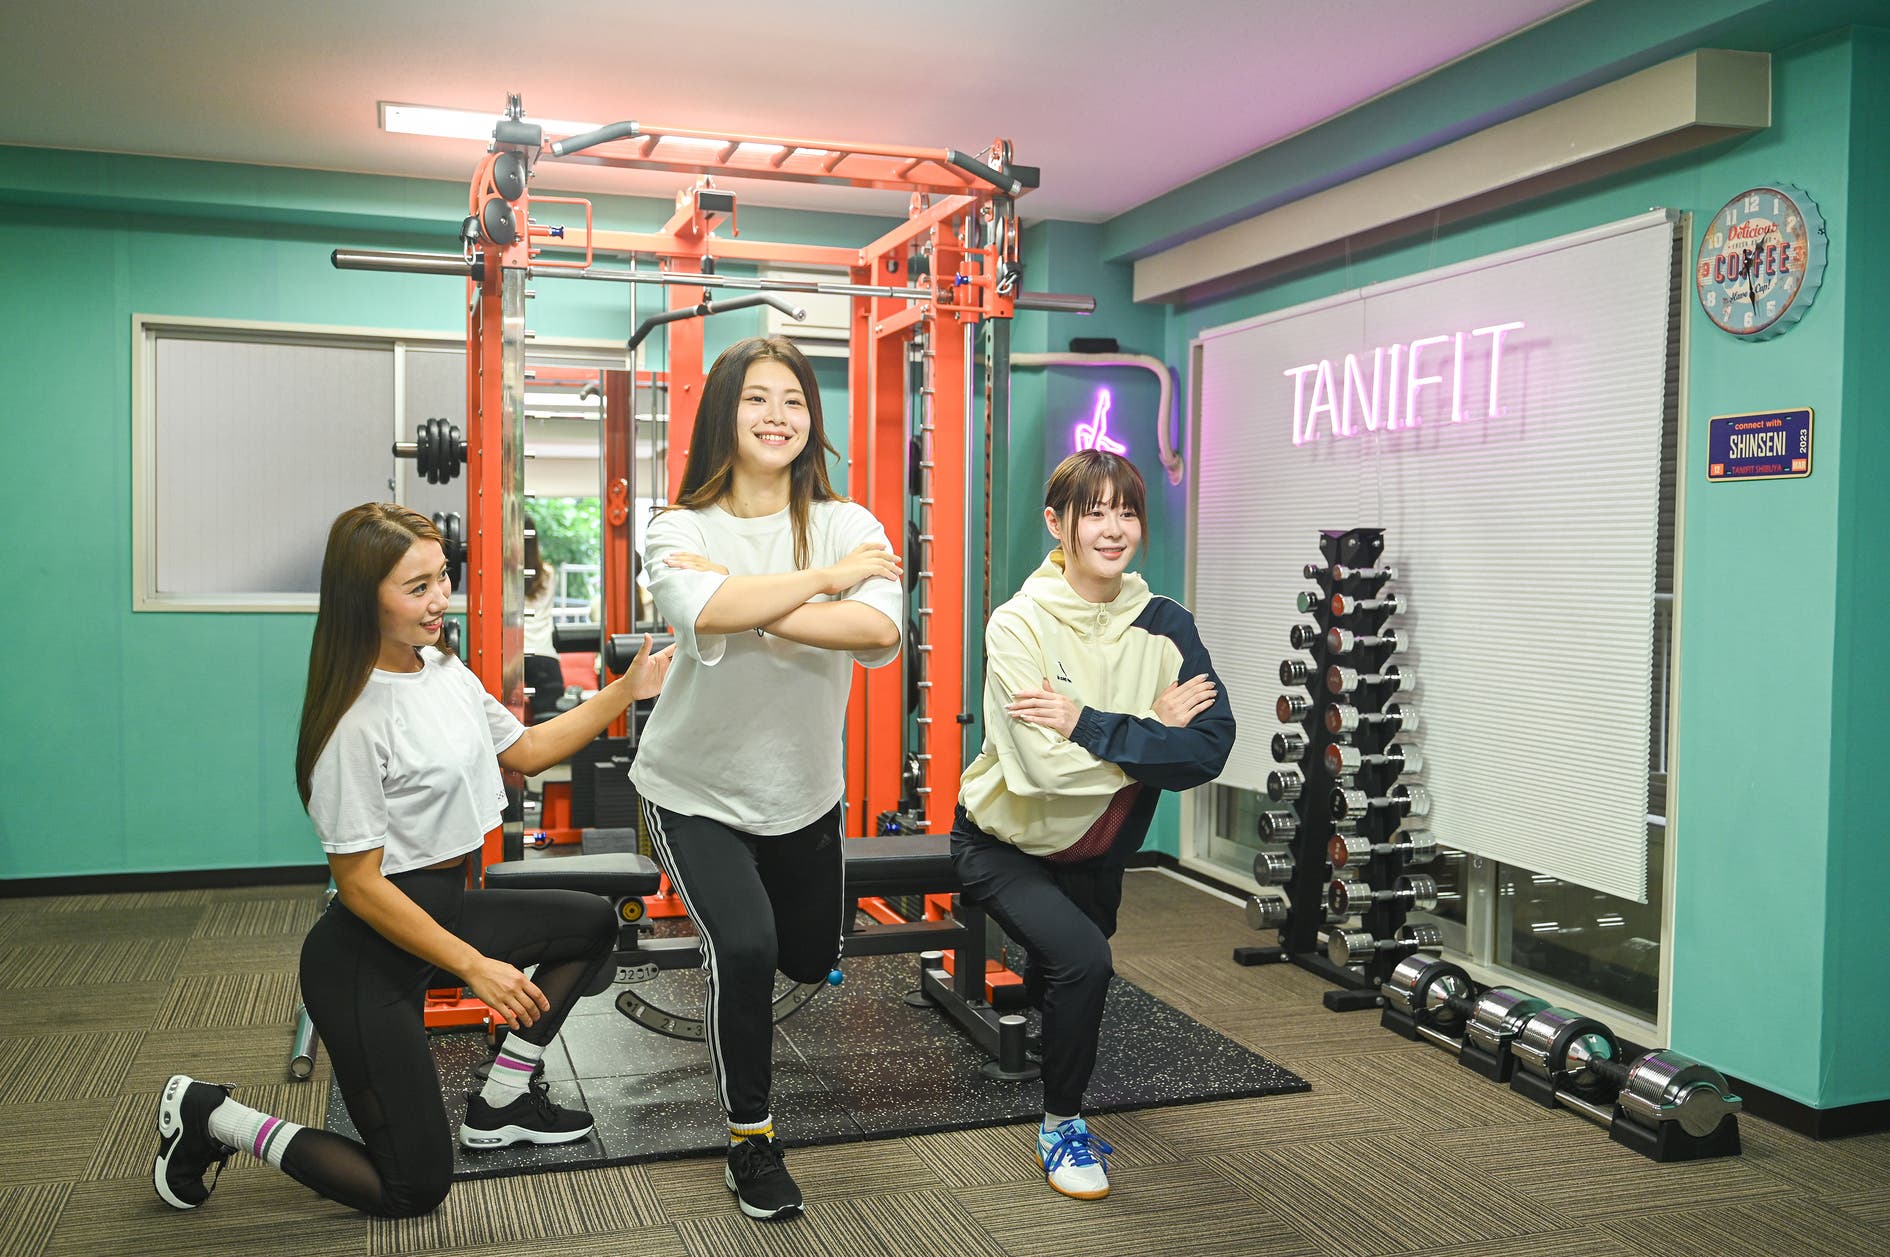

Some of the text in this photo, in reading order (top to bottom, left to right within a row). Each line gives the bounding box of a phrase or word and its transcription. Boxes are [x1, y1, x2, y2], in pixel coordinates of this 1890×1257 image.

[1744, 196, 1759, 213] 12
[1774, 197, 1779, 215] 1
[1726, 209, 1737, 225] 11
[1787, 217, 1796, 232] 2
[1728, 221, 1778, 241] Delicious
[1708, 232, 1723, 249] 10
[1794, 247, 1804, 263] 3
[1702, 263, 1710, 277] 9
[1755, 280, 1771, 294] Cup!
[1784, 277, 1793, 291] 4
[1708, 292, 1716, 306] 8
[1723, 307, 1731, 321] 7
[1744, 312, 1752, 327] 6
[1283, 321, 1525, 445] TANIFIT
[1734, 419, 1782, 430] connect with
[1799, 429, 1808, 454] 2023
[660, 1018, 670, 1030] 2
[695, 1025, 703, 1037] 3
